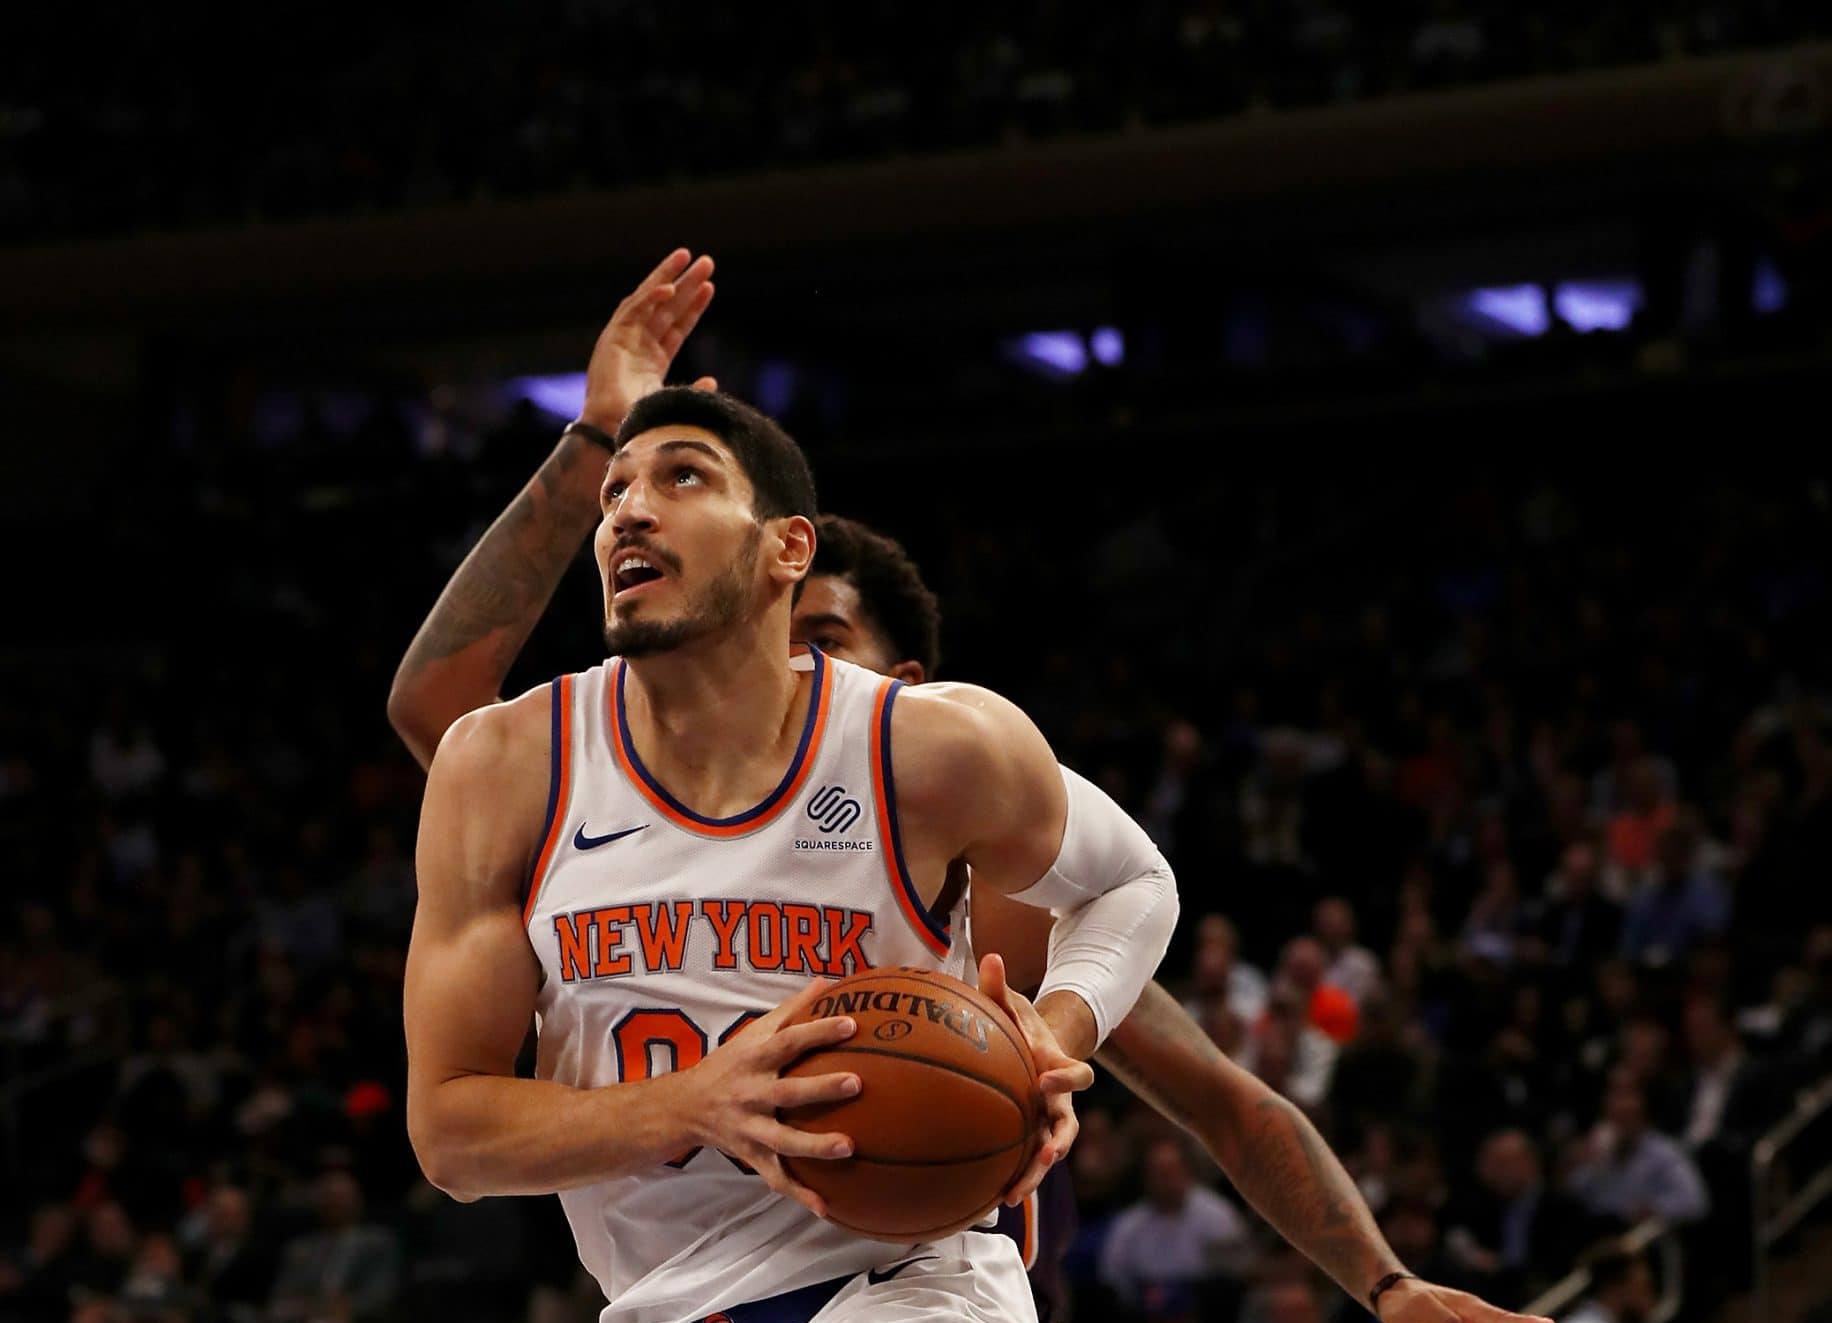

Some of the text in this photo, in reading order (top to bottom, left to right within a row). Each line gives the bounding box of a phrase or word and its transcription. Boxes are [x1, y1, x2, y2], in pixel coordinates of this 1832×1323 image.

[794, 839, 874, 851] SQUARESPACE
[552, 897, 876, 985] NEW YORK
[811, 990, 994, 1052] SPALDING
